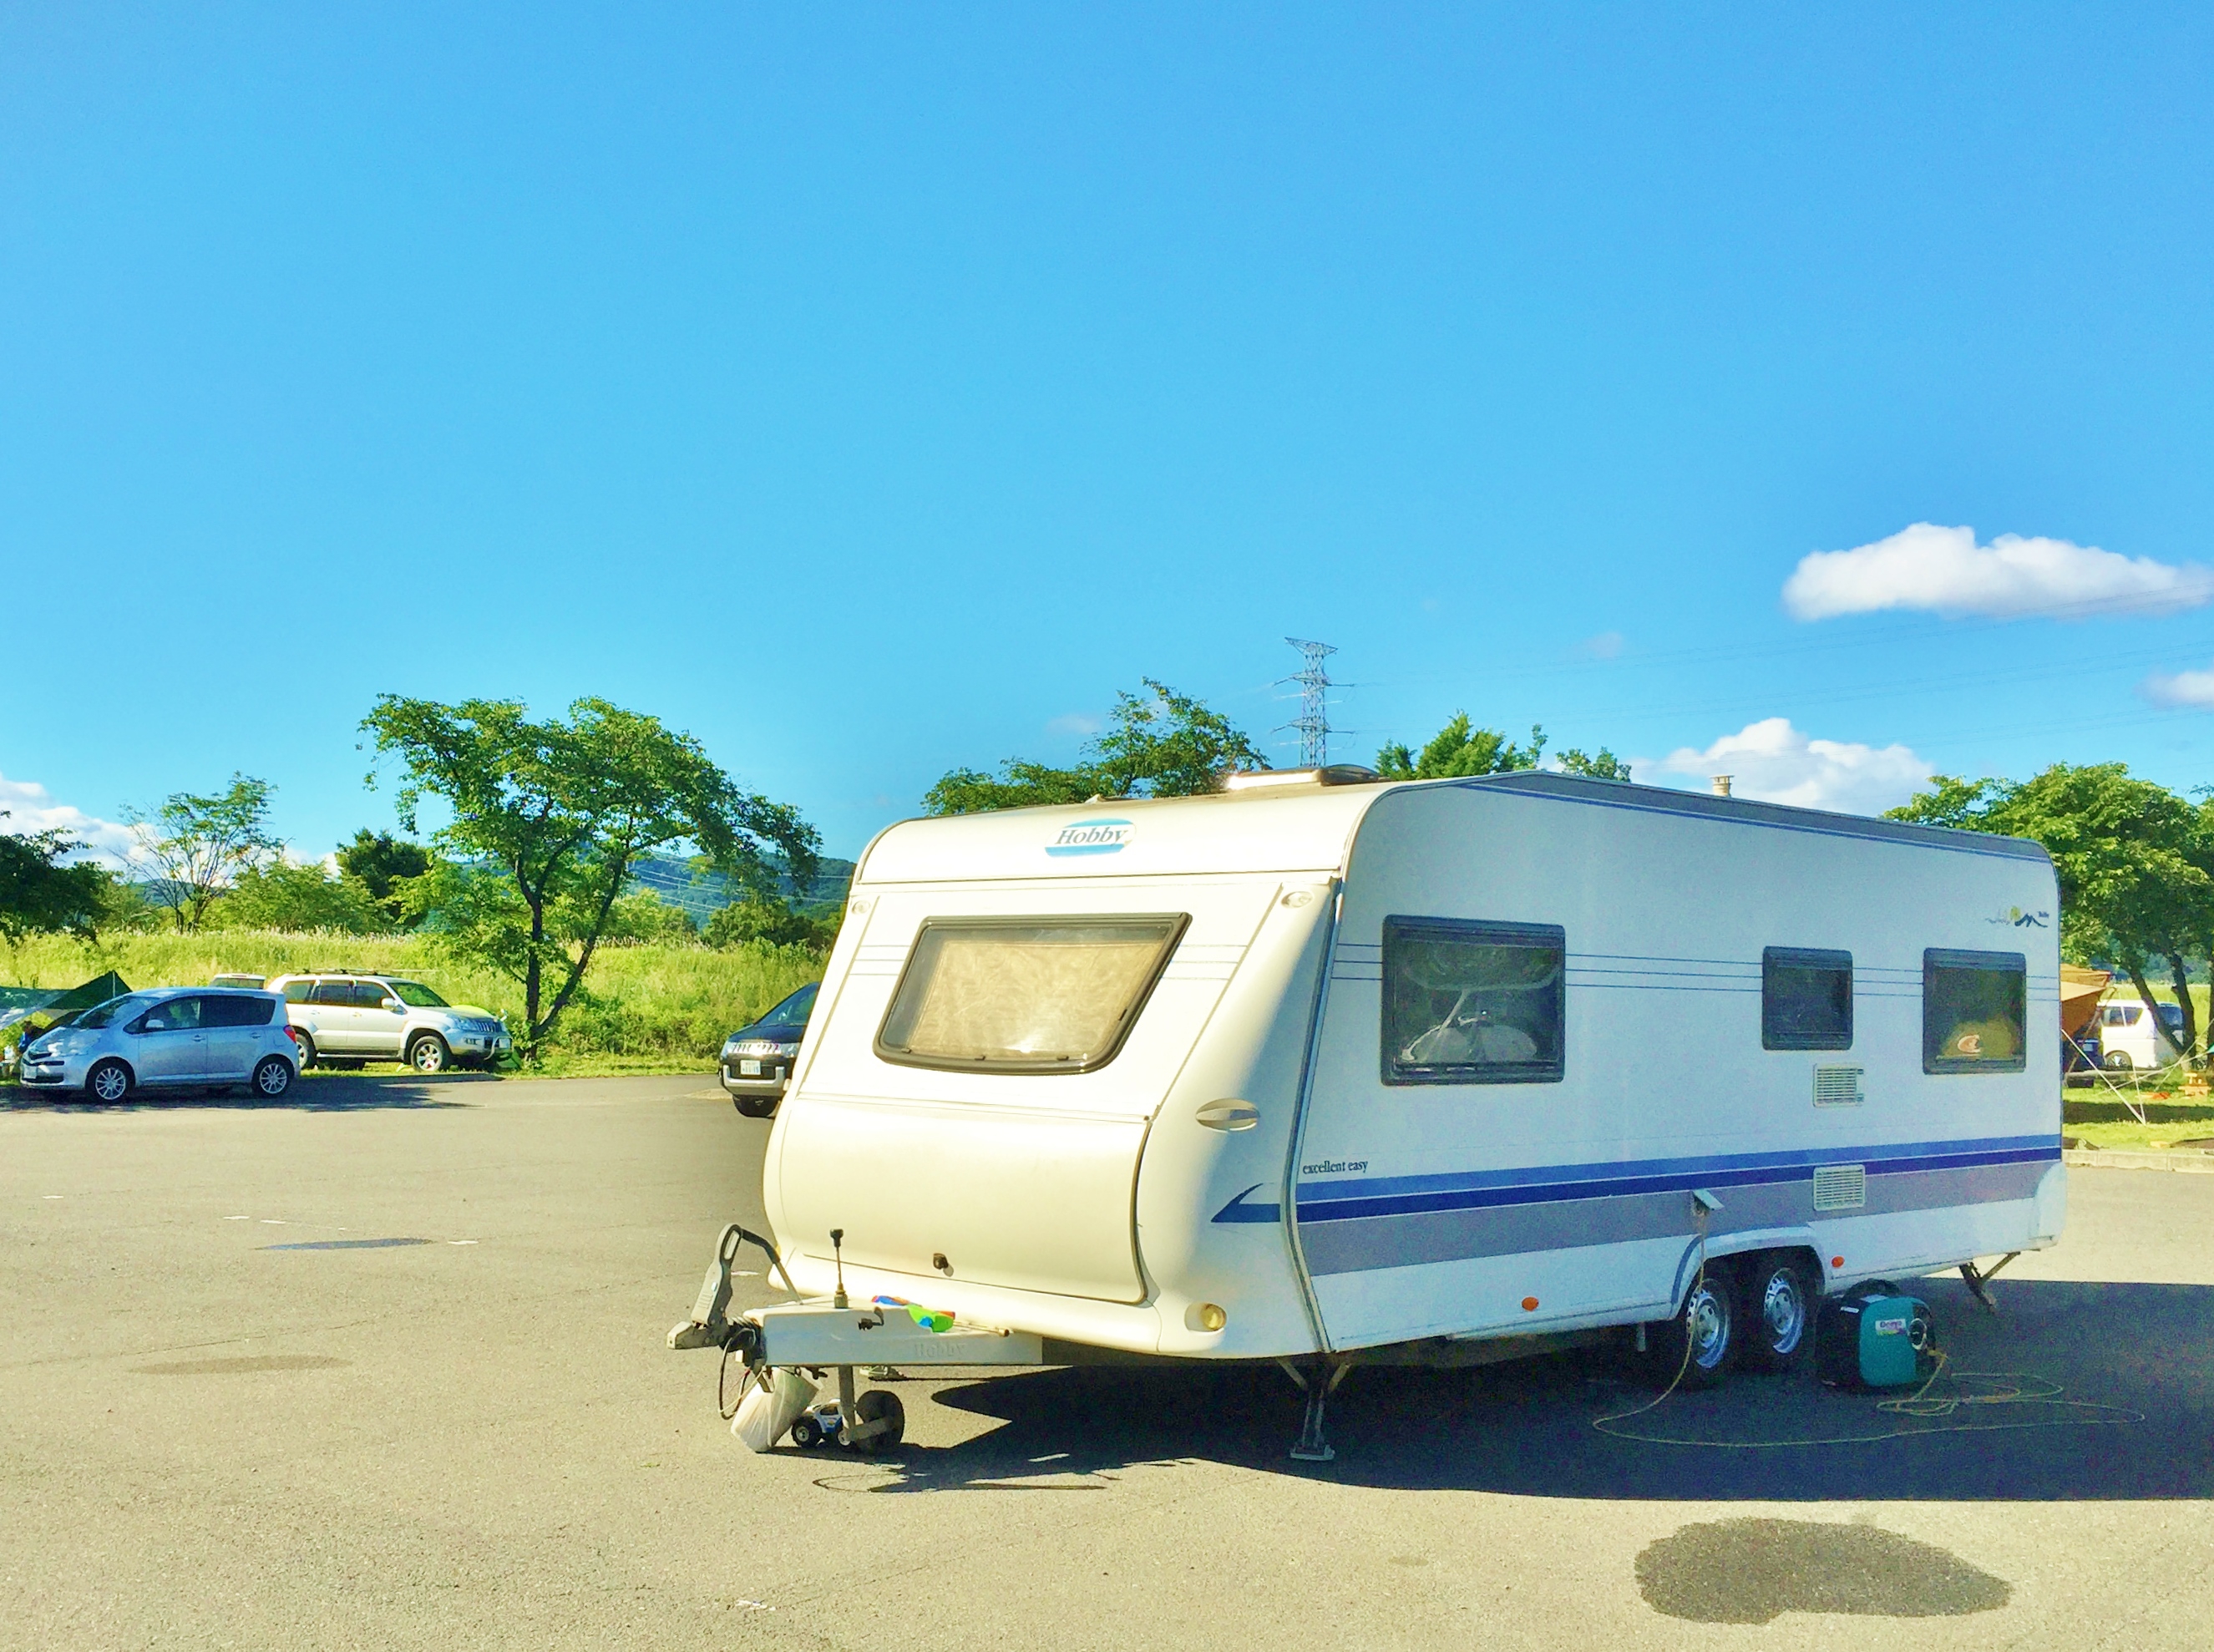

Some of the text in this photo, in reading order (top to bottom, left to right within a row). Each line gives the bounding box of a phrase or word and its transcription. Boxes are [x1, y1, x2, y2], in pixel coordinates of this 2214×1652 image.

[1054, 826, 1128, 847] Hobby
[1303, 1160, 1368, 1174] excellent easy
